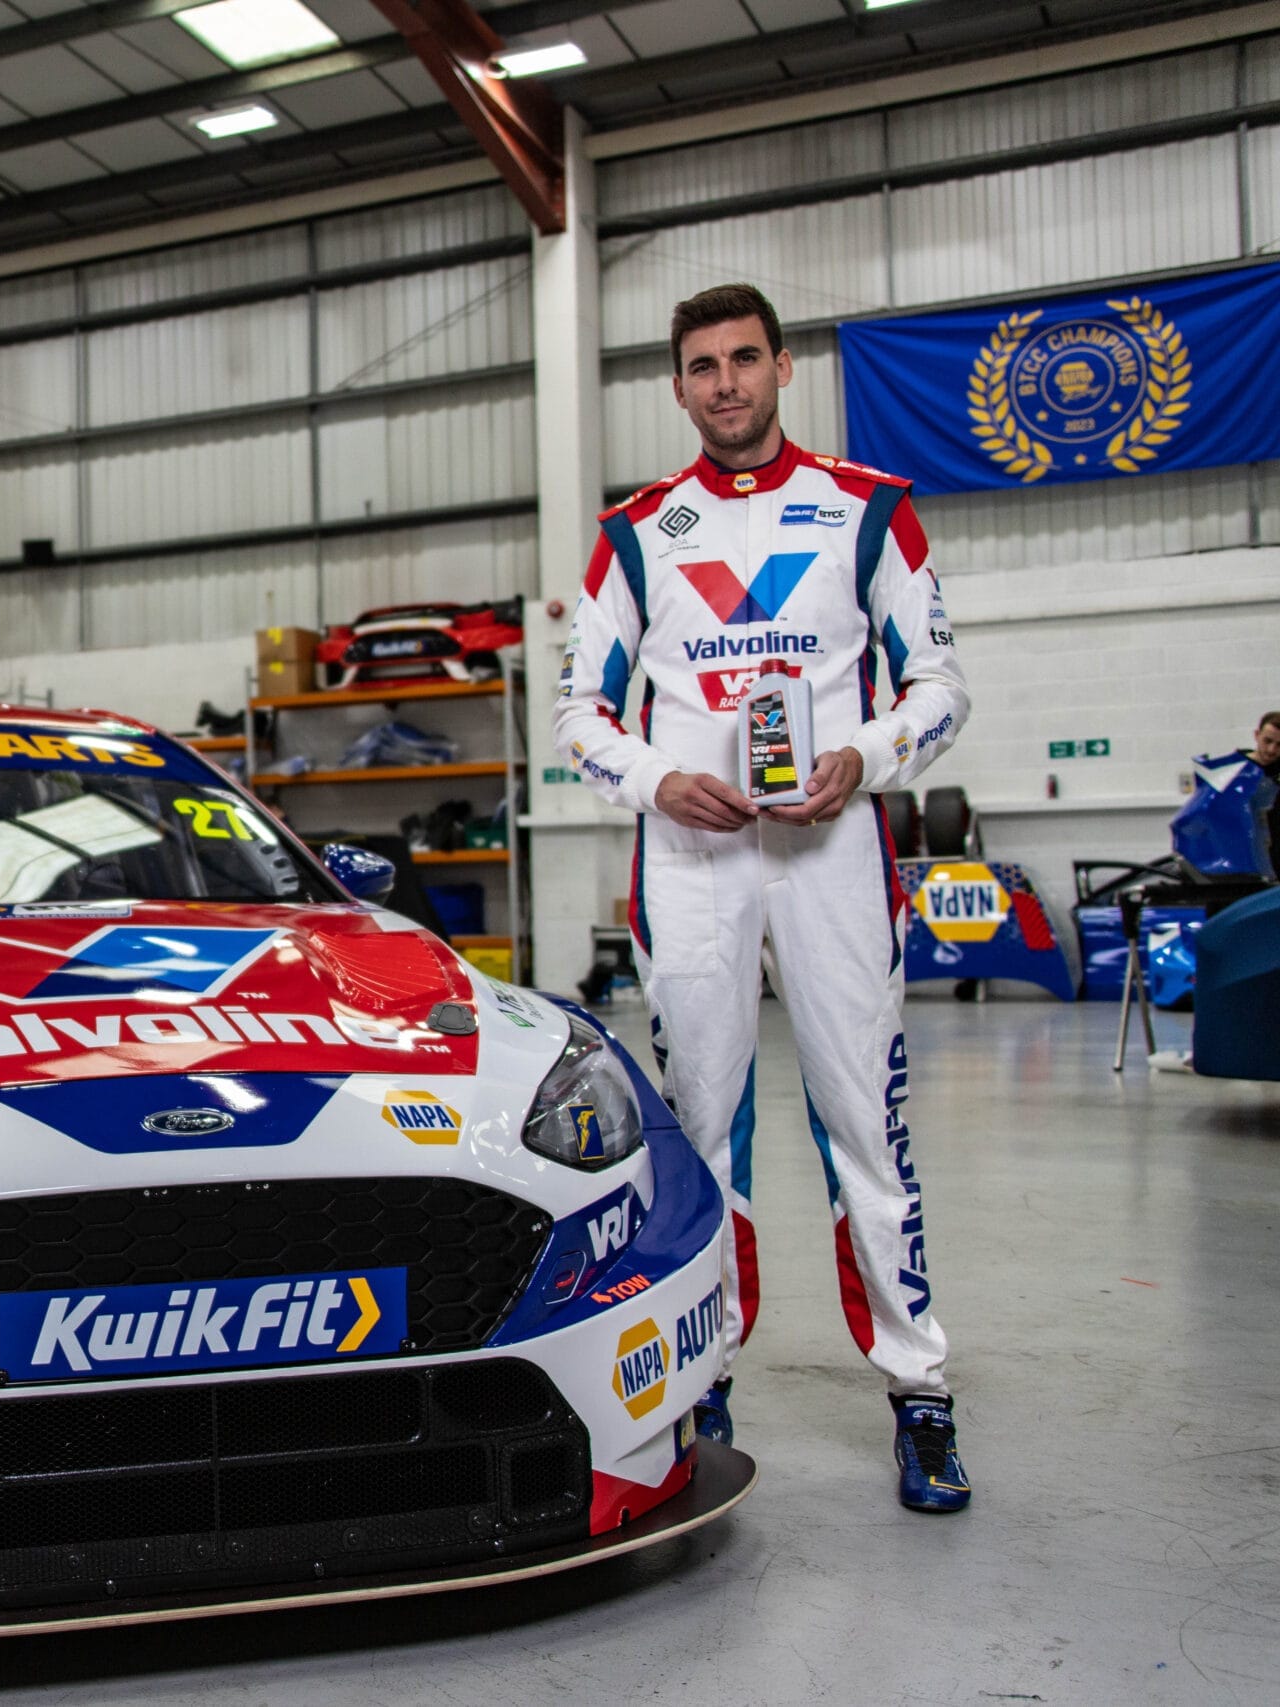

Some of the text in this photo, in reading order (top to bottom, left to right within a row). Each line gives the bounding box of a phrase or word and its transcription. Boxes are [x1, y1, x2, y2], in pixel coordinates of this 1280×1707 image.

[1018, 326, 1139, 397] BTCC CHAMPIONS
[682, 630, 818, 662] Valvoline
[173, 797, 254, 841] 27
[928, 884, 995, 918] NAPA
[390, 1104, 455, 1129] NAPA
[586, 1196, 630, 1263] VR1
[606, 1273, 651, 1301] TOW
[620, 1281, 725, 1398] NAPA AUTO
